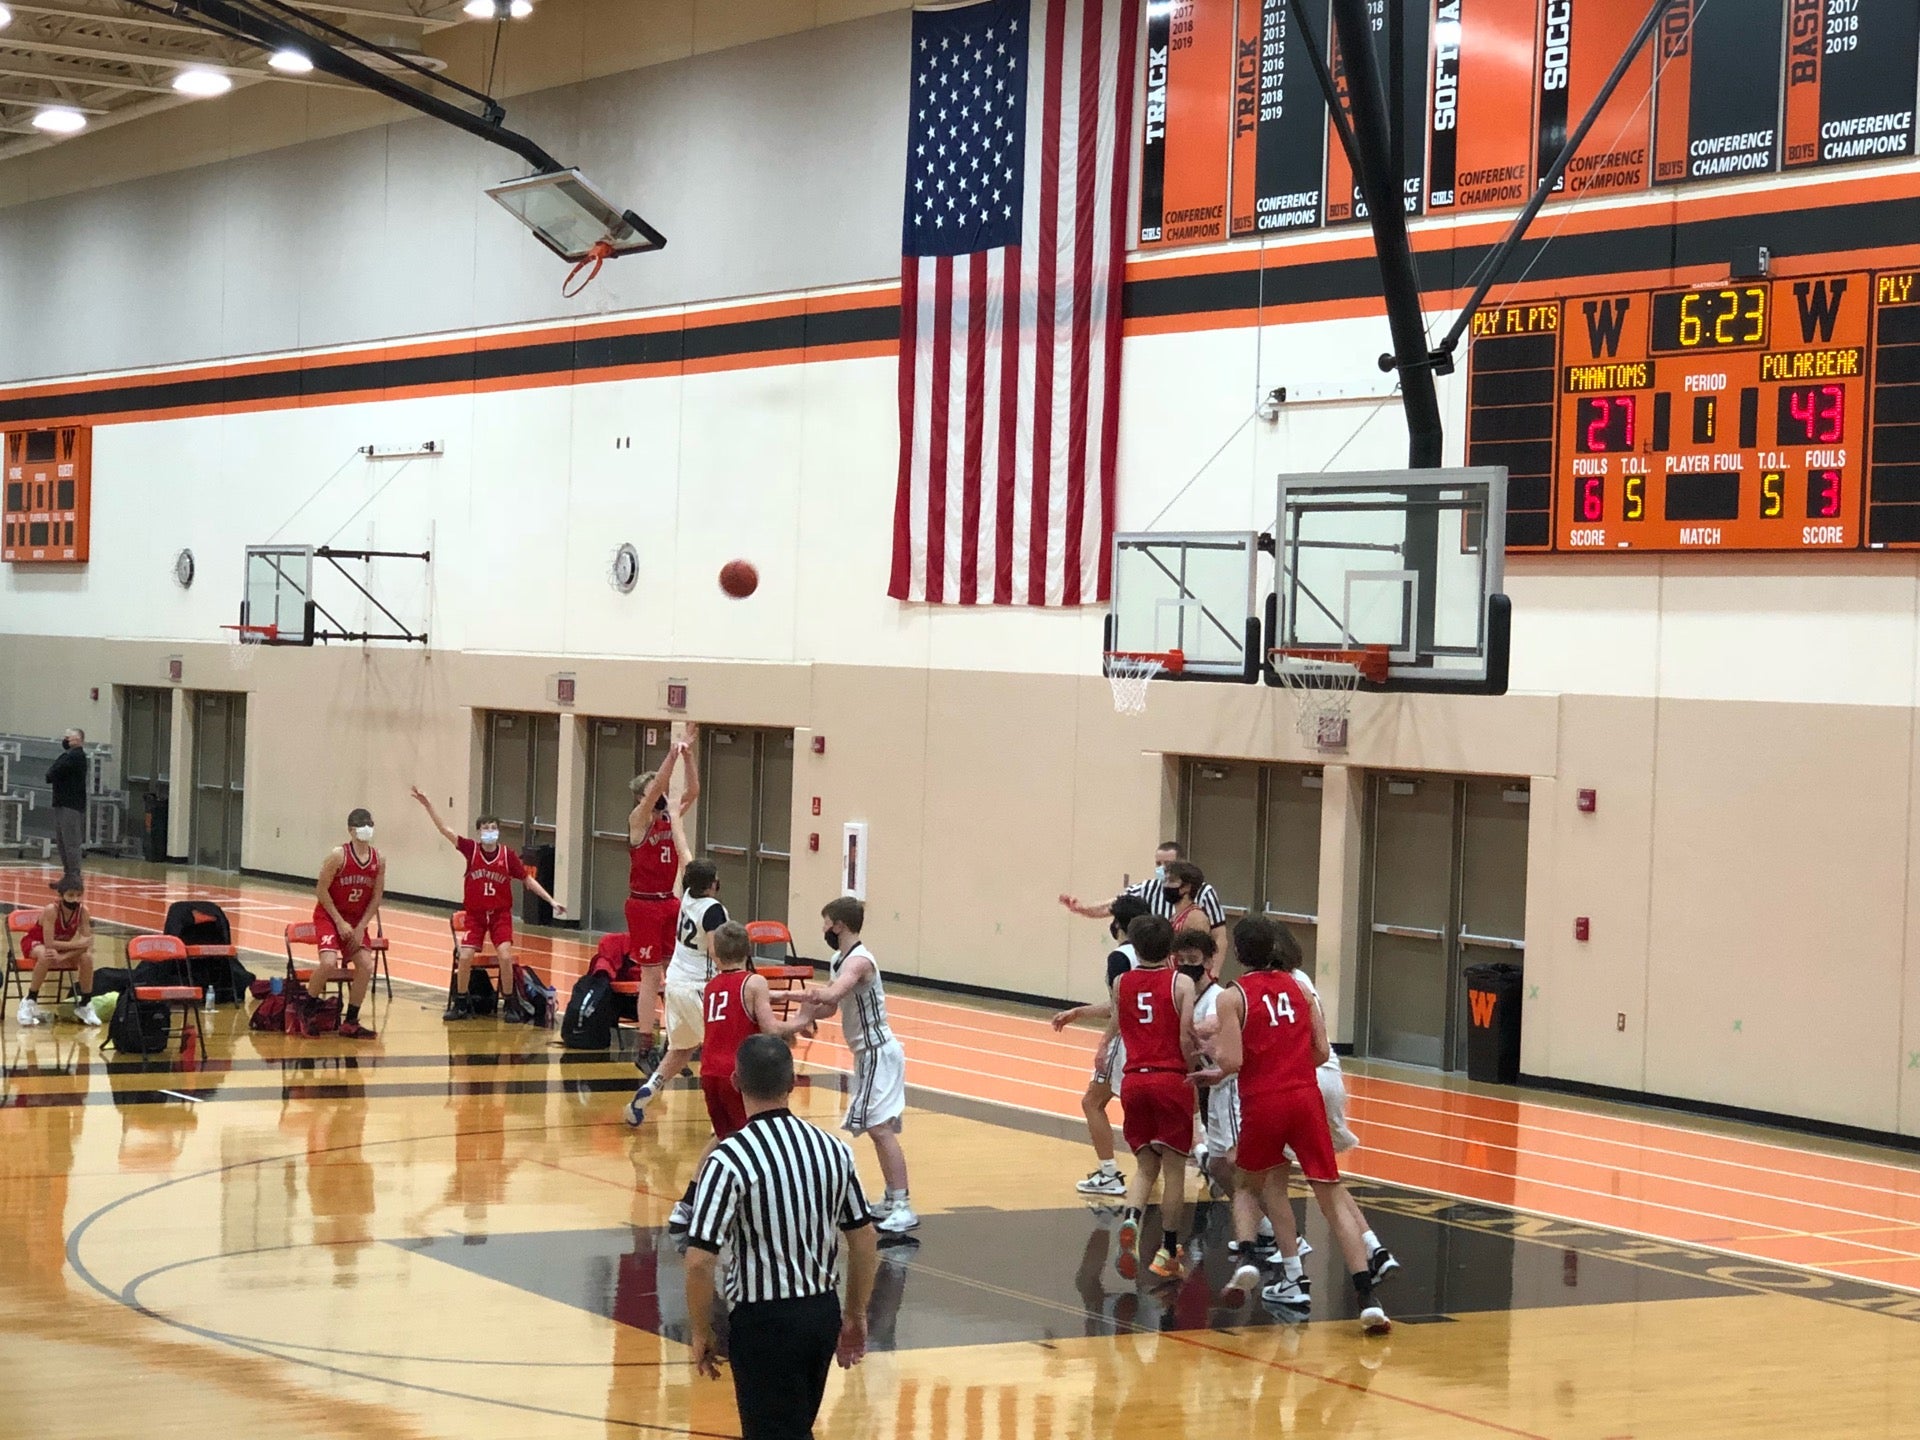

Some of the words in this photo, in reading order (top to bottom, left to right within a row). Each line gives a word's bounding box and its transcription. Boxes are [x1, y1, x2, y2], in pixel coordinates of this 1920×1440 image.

[1174, 5, 1194, 19] 2017
[1826, 0, 1859, 15] 2017
[1172, 20, 1194, 35] 2018
[1263, 10, 1286, 27] 2012
[1826, 15, 1859, 35] 2018
[1263, 25, 1286, 41] 2013
[1171, 36, 1193, 51] 2019
[1262, 41, 1285, 57] 2015
[1543, 0, 1571, 90] SOCC
[1825, 35, 1858, 54] 2019
[1262, 57, 1285, 73] 2016
[1236, 36, 1258, 139] TRACK
[1261, 74, 1284, 89] 2017
[1146, 45, 1168, 145] TRACK
[1260, 89, 1283, 105] 2018
[1260, 106, 1283, 122] 2019
[1821, 112, 1913, 139] CONFERENCE
[1690, 130, 1774, 157] CONFERENCE
[1788, 144, 1815, 160] BOYS
[1823, 134, 1908, 160] CHAMPIONS
[1568, 149, 1645, 173] CONFERENCE
[1658, 161, 1684, 177] BOYS
[1692, 152, 1770, 176] CHAMPIONS
[1458, 164, 1525, 188] CONFERENCE
[1570, 169, 1641, 192] CHAMPIONS
[1256, 190, 1318, 212] CONFERENCE
[1431, 190, 1454, 206] GIRLS
[1459, 185, 1523, 206] CHAMPIONS
[1164, 205, 1223, 225] CONFERENCE
[1258, 209, 1316, 230] CHAMPIONS
[1141, 226, 1162, 241] GIRLS
[1166, 223, 1220, 242] CHAMPIONS
[1878, 275, 1913, 303] PLY
[1680, 289, 1765, 345] 6:23
[1793, 278, 1848, 343] W
[1473, 312, 1500, 336] PLY
[1507, 309, 1524, 332] FL
[1528, 306, 1557, 331] PTS
[1582, 298, 1630, 359] W
[1570, 363, 1647, 391] PHANTOMS
[1685, 373, 1727, 392] PERIOD
[1587, 396, 1635, 450] 27
[1790, 385, 1843, 443] 43
[62, 429, 75, 459] W
[1572, 458, 1608, 475] FOULS
[1620, 457, 1651, 474] T.O.L.
[1666, 455, 1710, 473] PLAYER
[1714, 453, 1744, 471] FOUL
[1758, 452, 1791, 470] T.O.L.
[1805, 449, 1847, 468] FOULS
[1584, 478, 1600, 520] 6
[1626, 478, 1642, 518] 5
[1764, 474, 1780, 516] 5
[1821, 470, 1839, 516] 3
[1570, 529, 1605, 546] SCORE
[1679, 528, 1721, 545] MATCH
[1802, 525, 1844, 544] SCORE
[660, 846, 672, 863] 21
[483, 882, 496, 896] 15
[708, 990, 729, 1023] 12
[1137, 991, 1153, 1025] 5
[1262, 991, 1296, 1027] 14
[1469, 988, 1497, 1029] W
